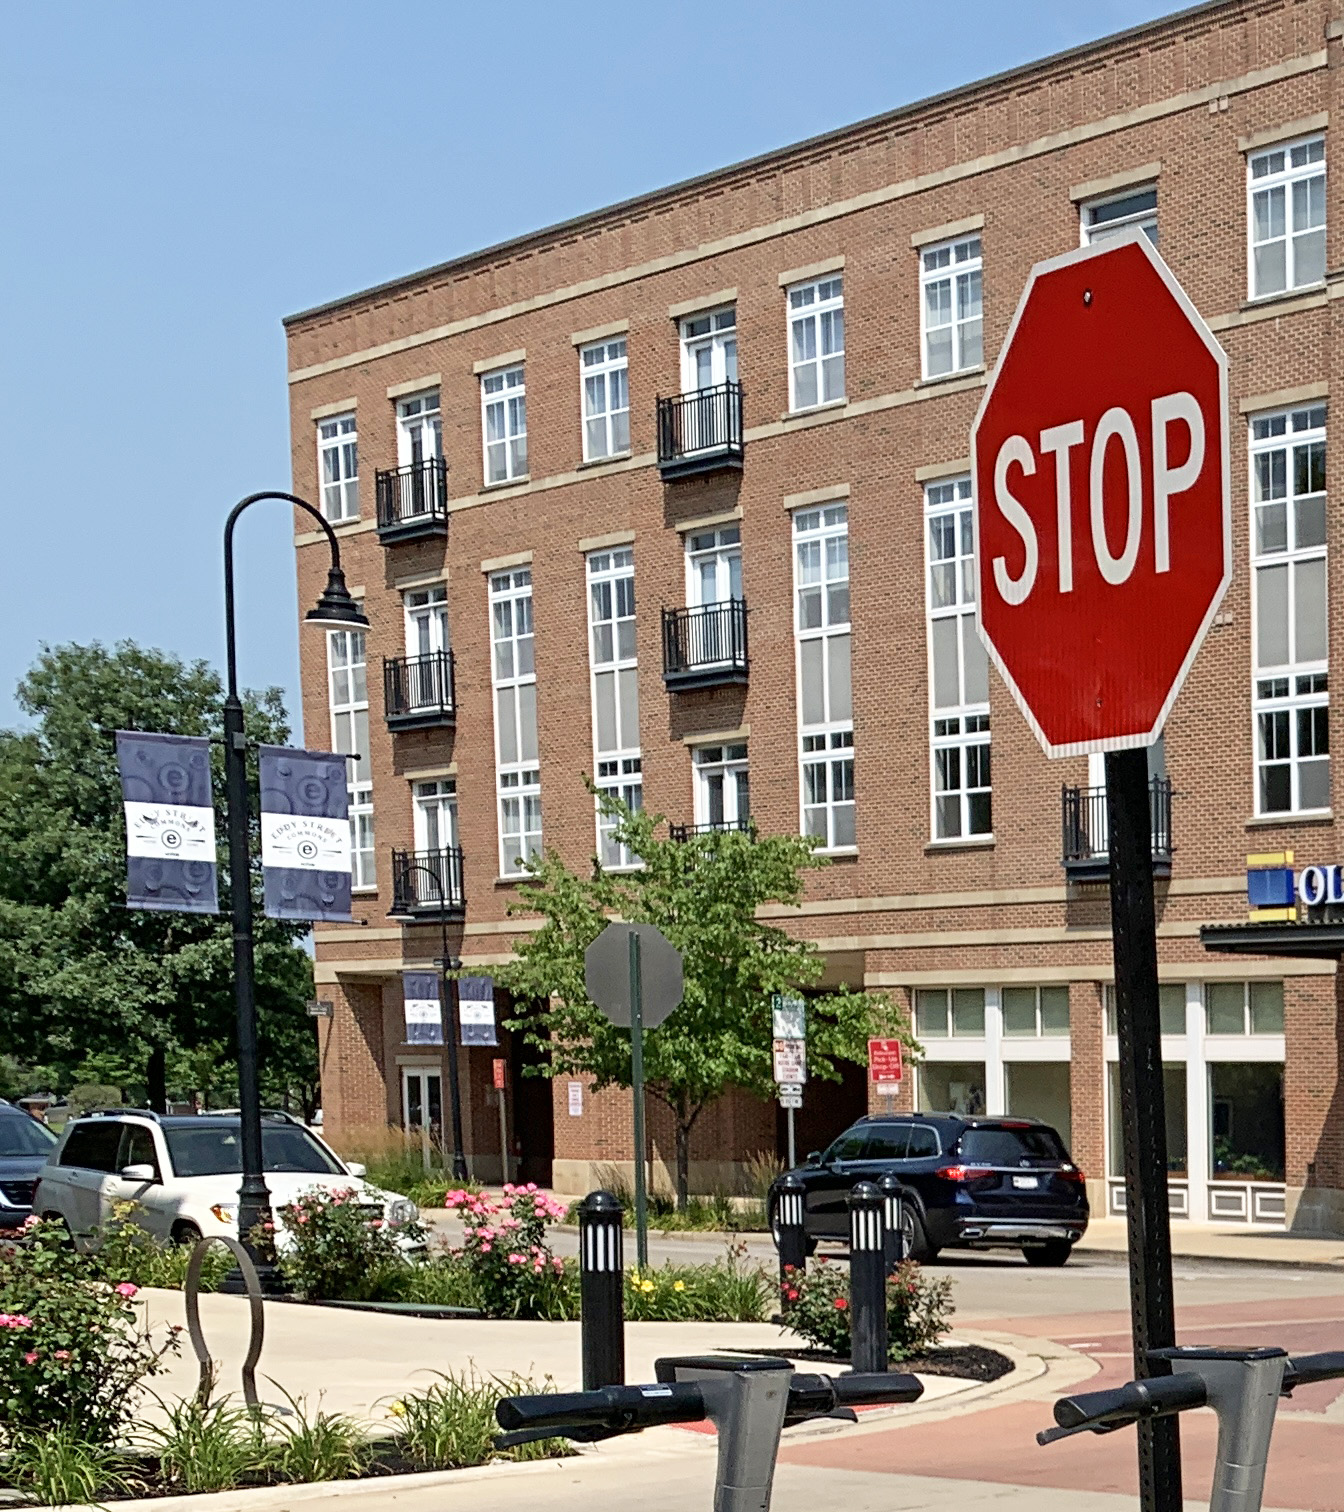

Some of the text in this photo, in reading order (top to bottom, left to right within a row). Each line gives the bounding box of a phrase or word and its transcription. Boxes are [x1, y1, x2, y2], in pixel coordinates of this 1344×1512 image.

[992, 391, 1206, 606] STOP
[271, 820, 343, 843] EDDY STREET
